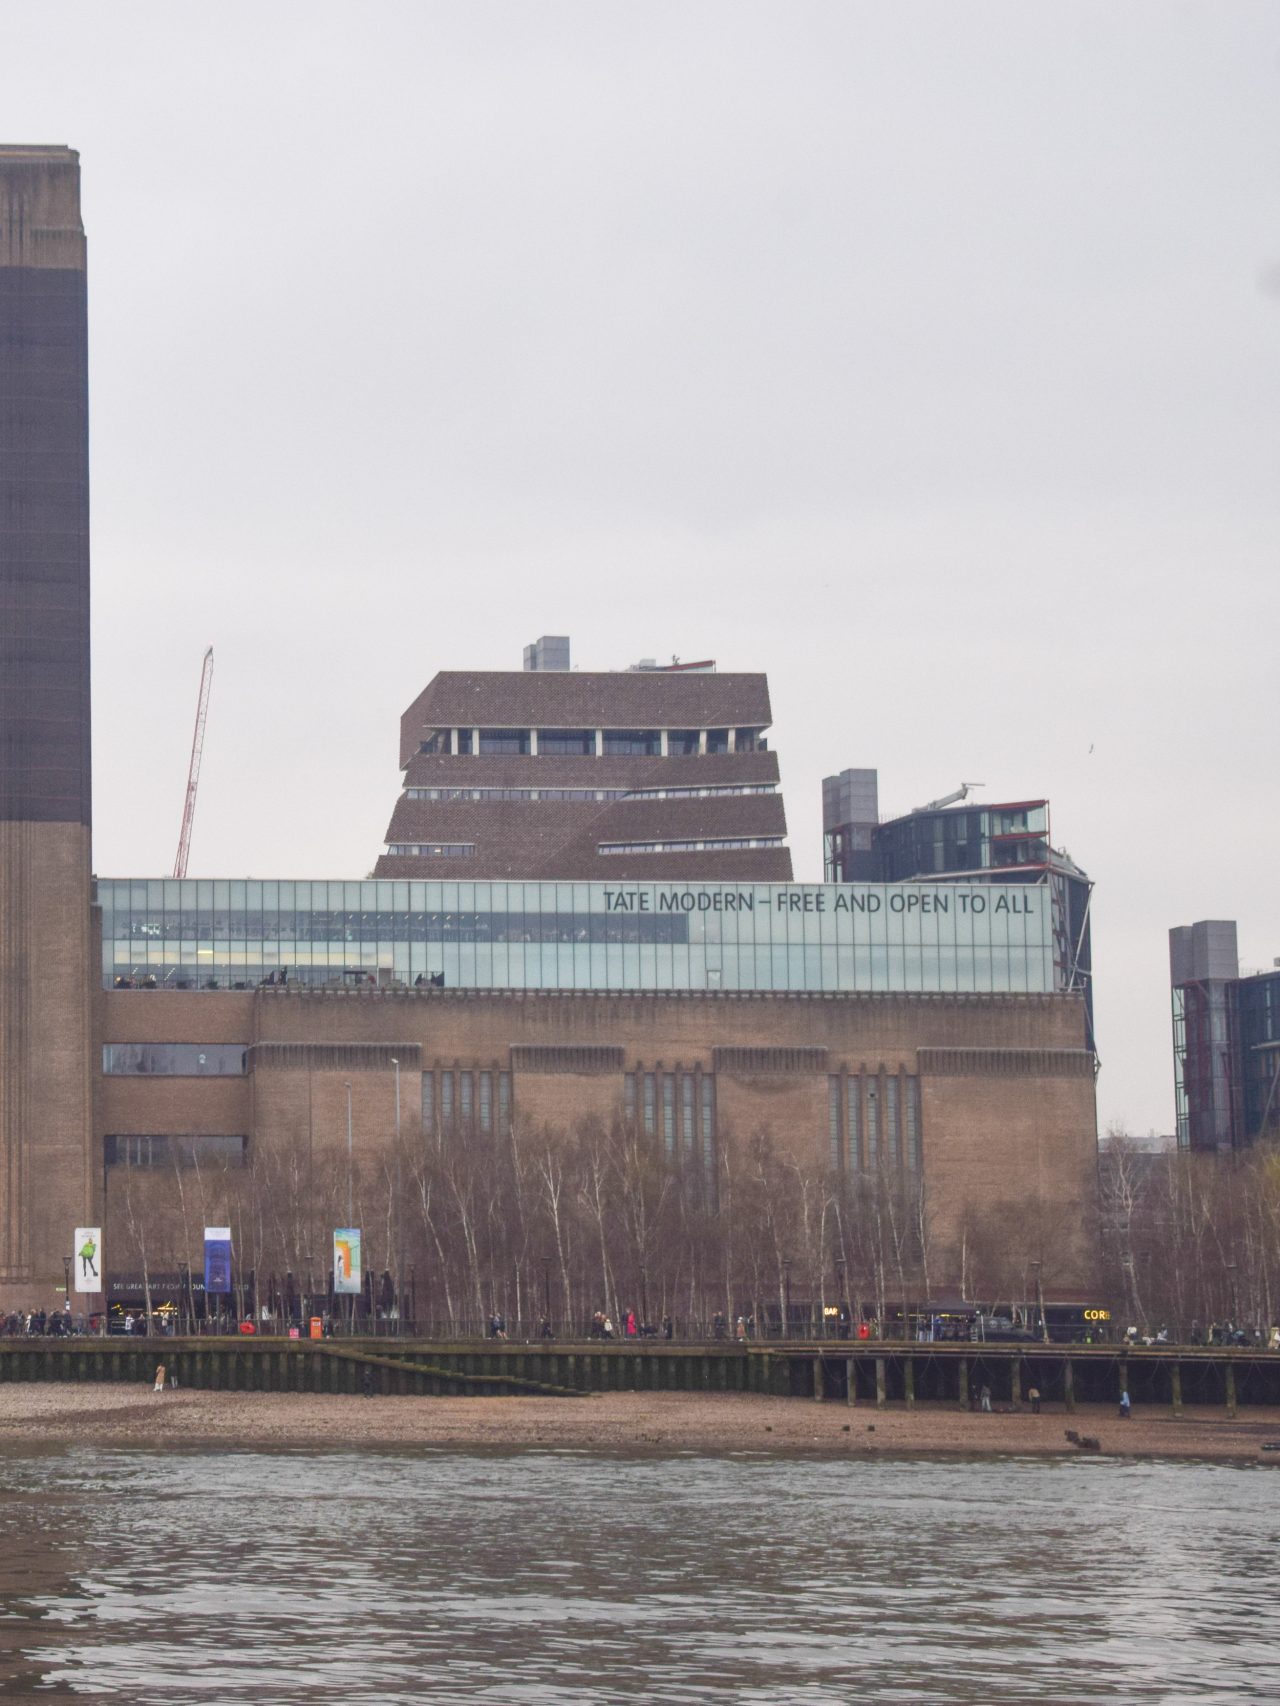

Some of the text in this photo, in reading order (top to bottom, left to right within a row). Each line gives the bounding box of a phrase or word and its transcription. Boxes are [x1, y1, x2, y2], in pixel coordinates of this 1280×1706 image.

[603, 892, 649, 912] TATE
[659, 892, 753, 912] MODERN
[777, 893, 825, 912] FREE
[834, 893, 881, 913] AND
[890, 893, 948, 913] OPEN
[958, 894, 986, 914] TO
[995, 894, 1034, 914] ALL
[824, 1307, 838, 1316] BAR
